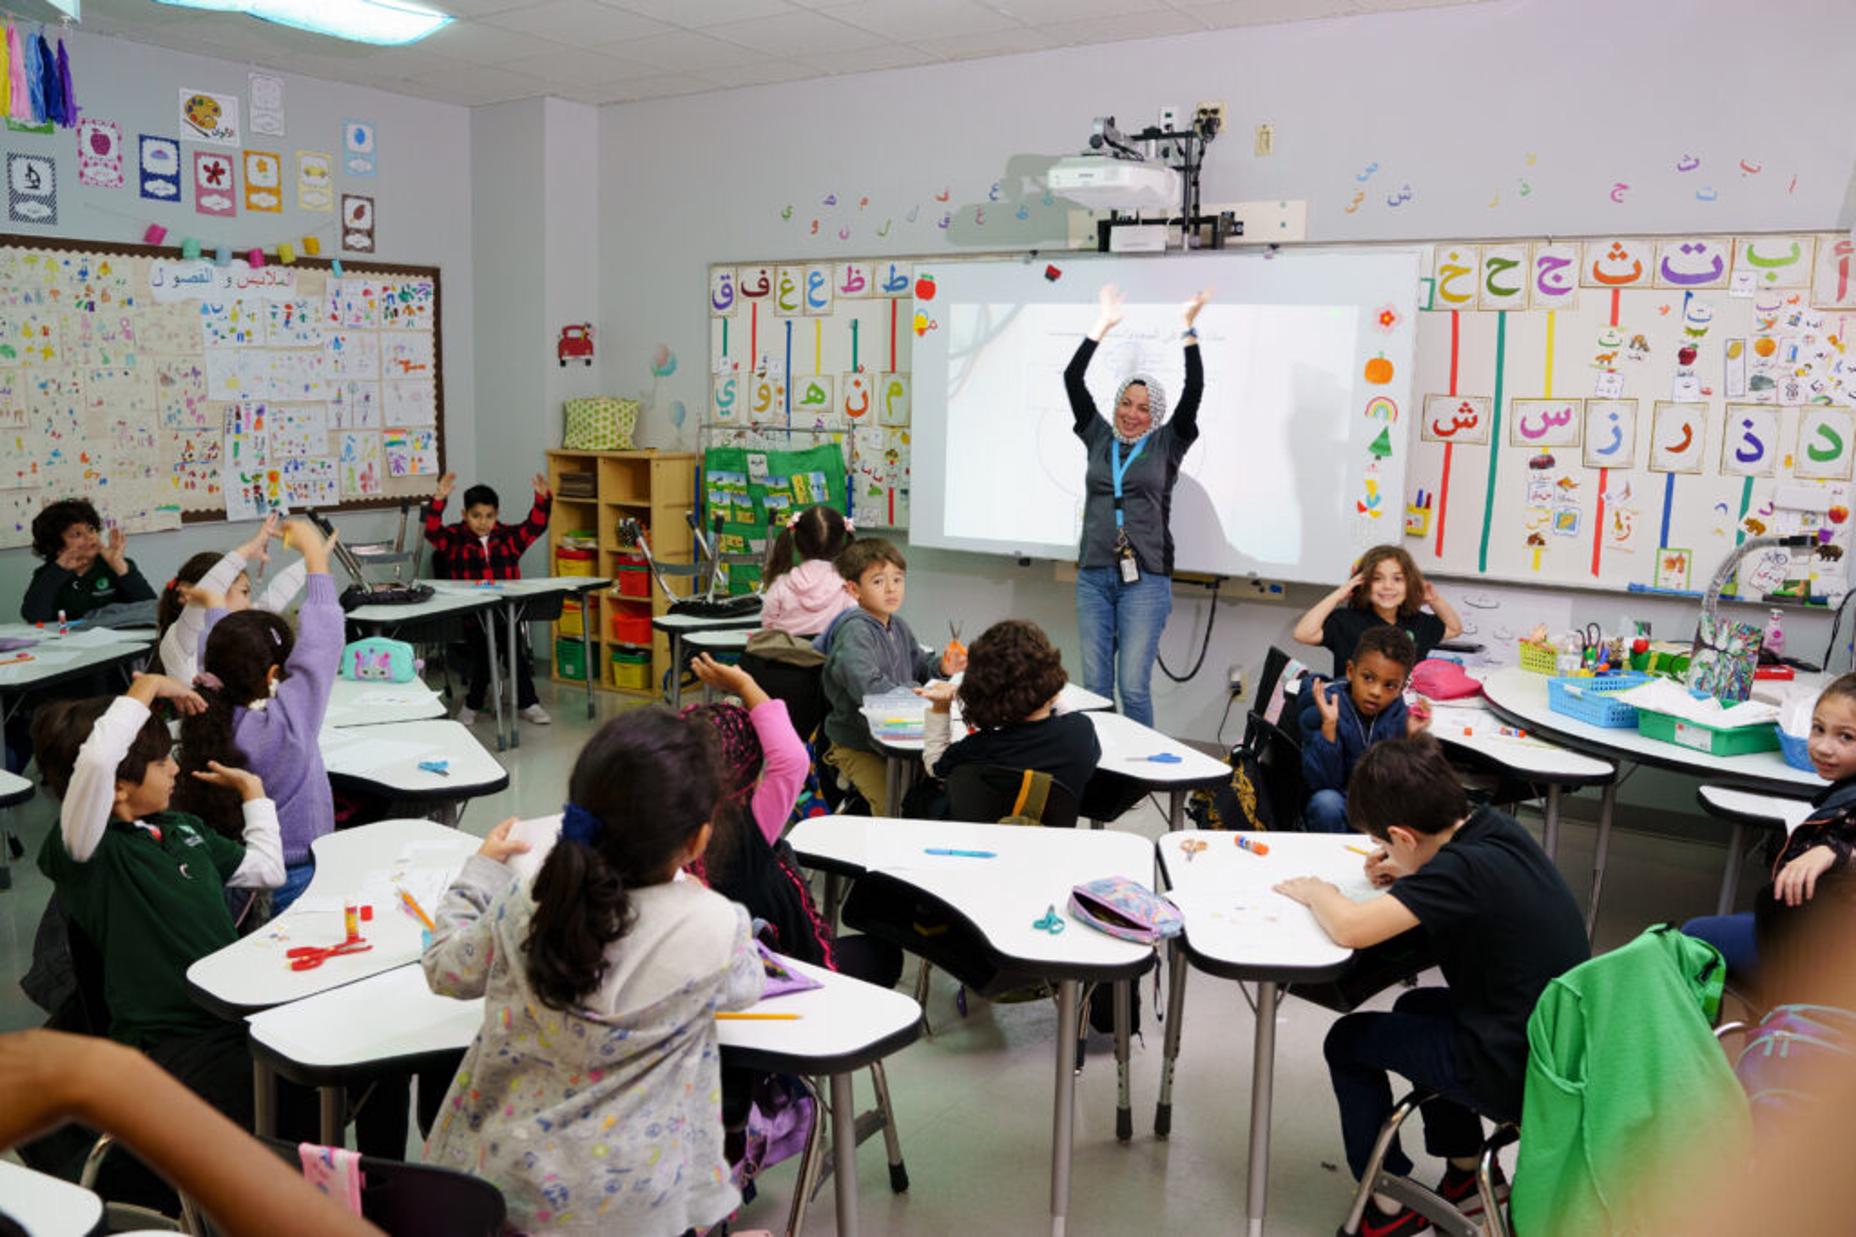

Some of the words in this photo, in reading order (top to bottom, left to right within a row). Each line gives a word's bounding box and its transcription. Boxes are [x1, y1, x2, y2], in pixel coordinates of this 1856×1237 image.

[840, 262, 865, 293] ظ
[882, 264, 909, 293] ط
[1439, 252, 1472, 303] خ
[1486, 257, 1520, 297] ح
[1536, 256, 1573, 296] ج
[1592, 242, 1642, 285] ث
[1660, 243, 1724, 285] ت
[1746, 243, 1800, 281] ب
[712, 274, 733, 310] ق
[741, 270, 770, 297] ف
[778, 270, 800, 311] غ
[808, 271, 827, 308] ع
[715, 379, 736, 416] ي
[753, 384, 772, 413] و
[845, 379, 868, 418] ن
[886, 381, 904, 417] م
[1433, 402, 1478, 437] ش
[1520, 407, 1572, 439] س
[1596, 412, 1622, 455] ز
[1665, 423, 1693, 453] ر
[1736, 419, 1764, 463] ذ
[1807, 423, 1843, 462] د
